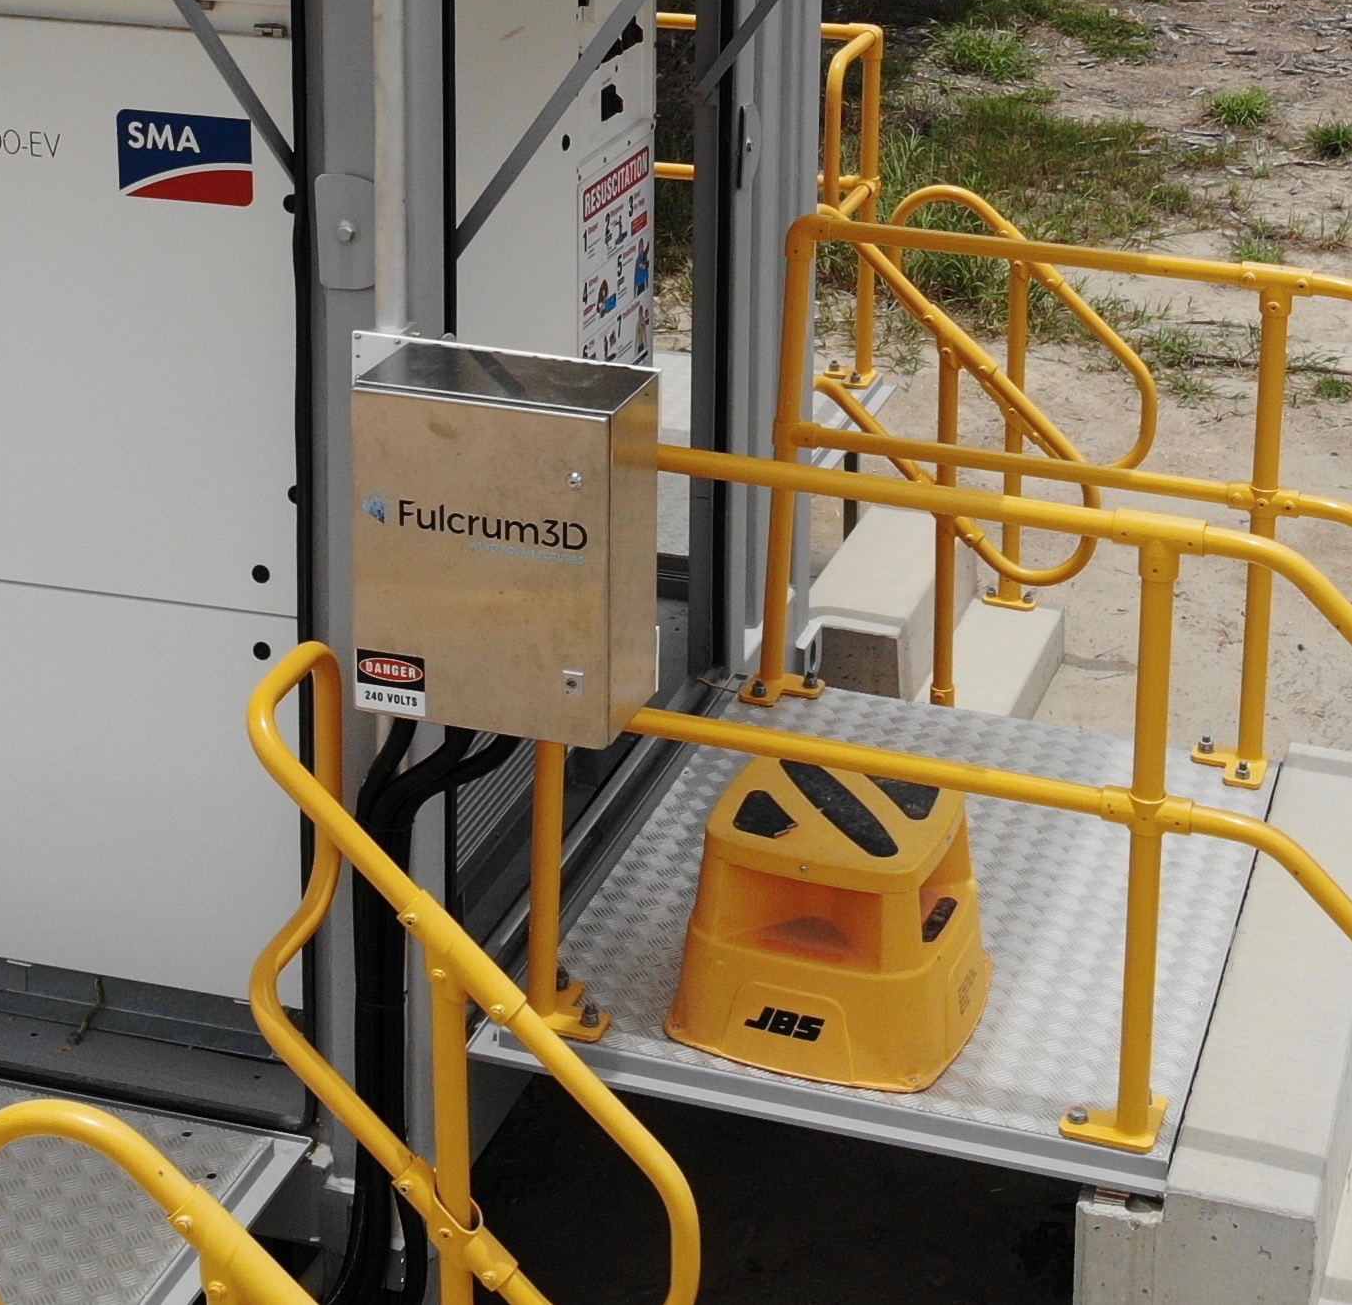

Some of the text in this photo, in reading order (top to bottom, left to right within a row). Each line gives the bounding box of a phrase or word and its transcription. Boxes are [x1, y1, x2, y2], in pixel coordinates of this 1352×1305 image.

[127, 121, 201, 154] SMA
[584, 150, 648, 217] RESUSCITATION
[398, 499, 588, 551] Fulcrum3D
[365, 660, 416, 679] DANGER
[364, 690, 418, 707] 240 VOLTS
[744, 1006, 825, 1042] JBS
